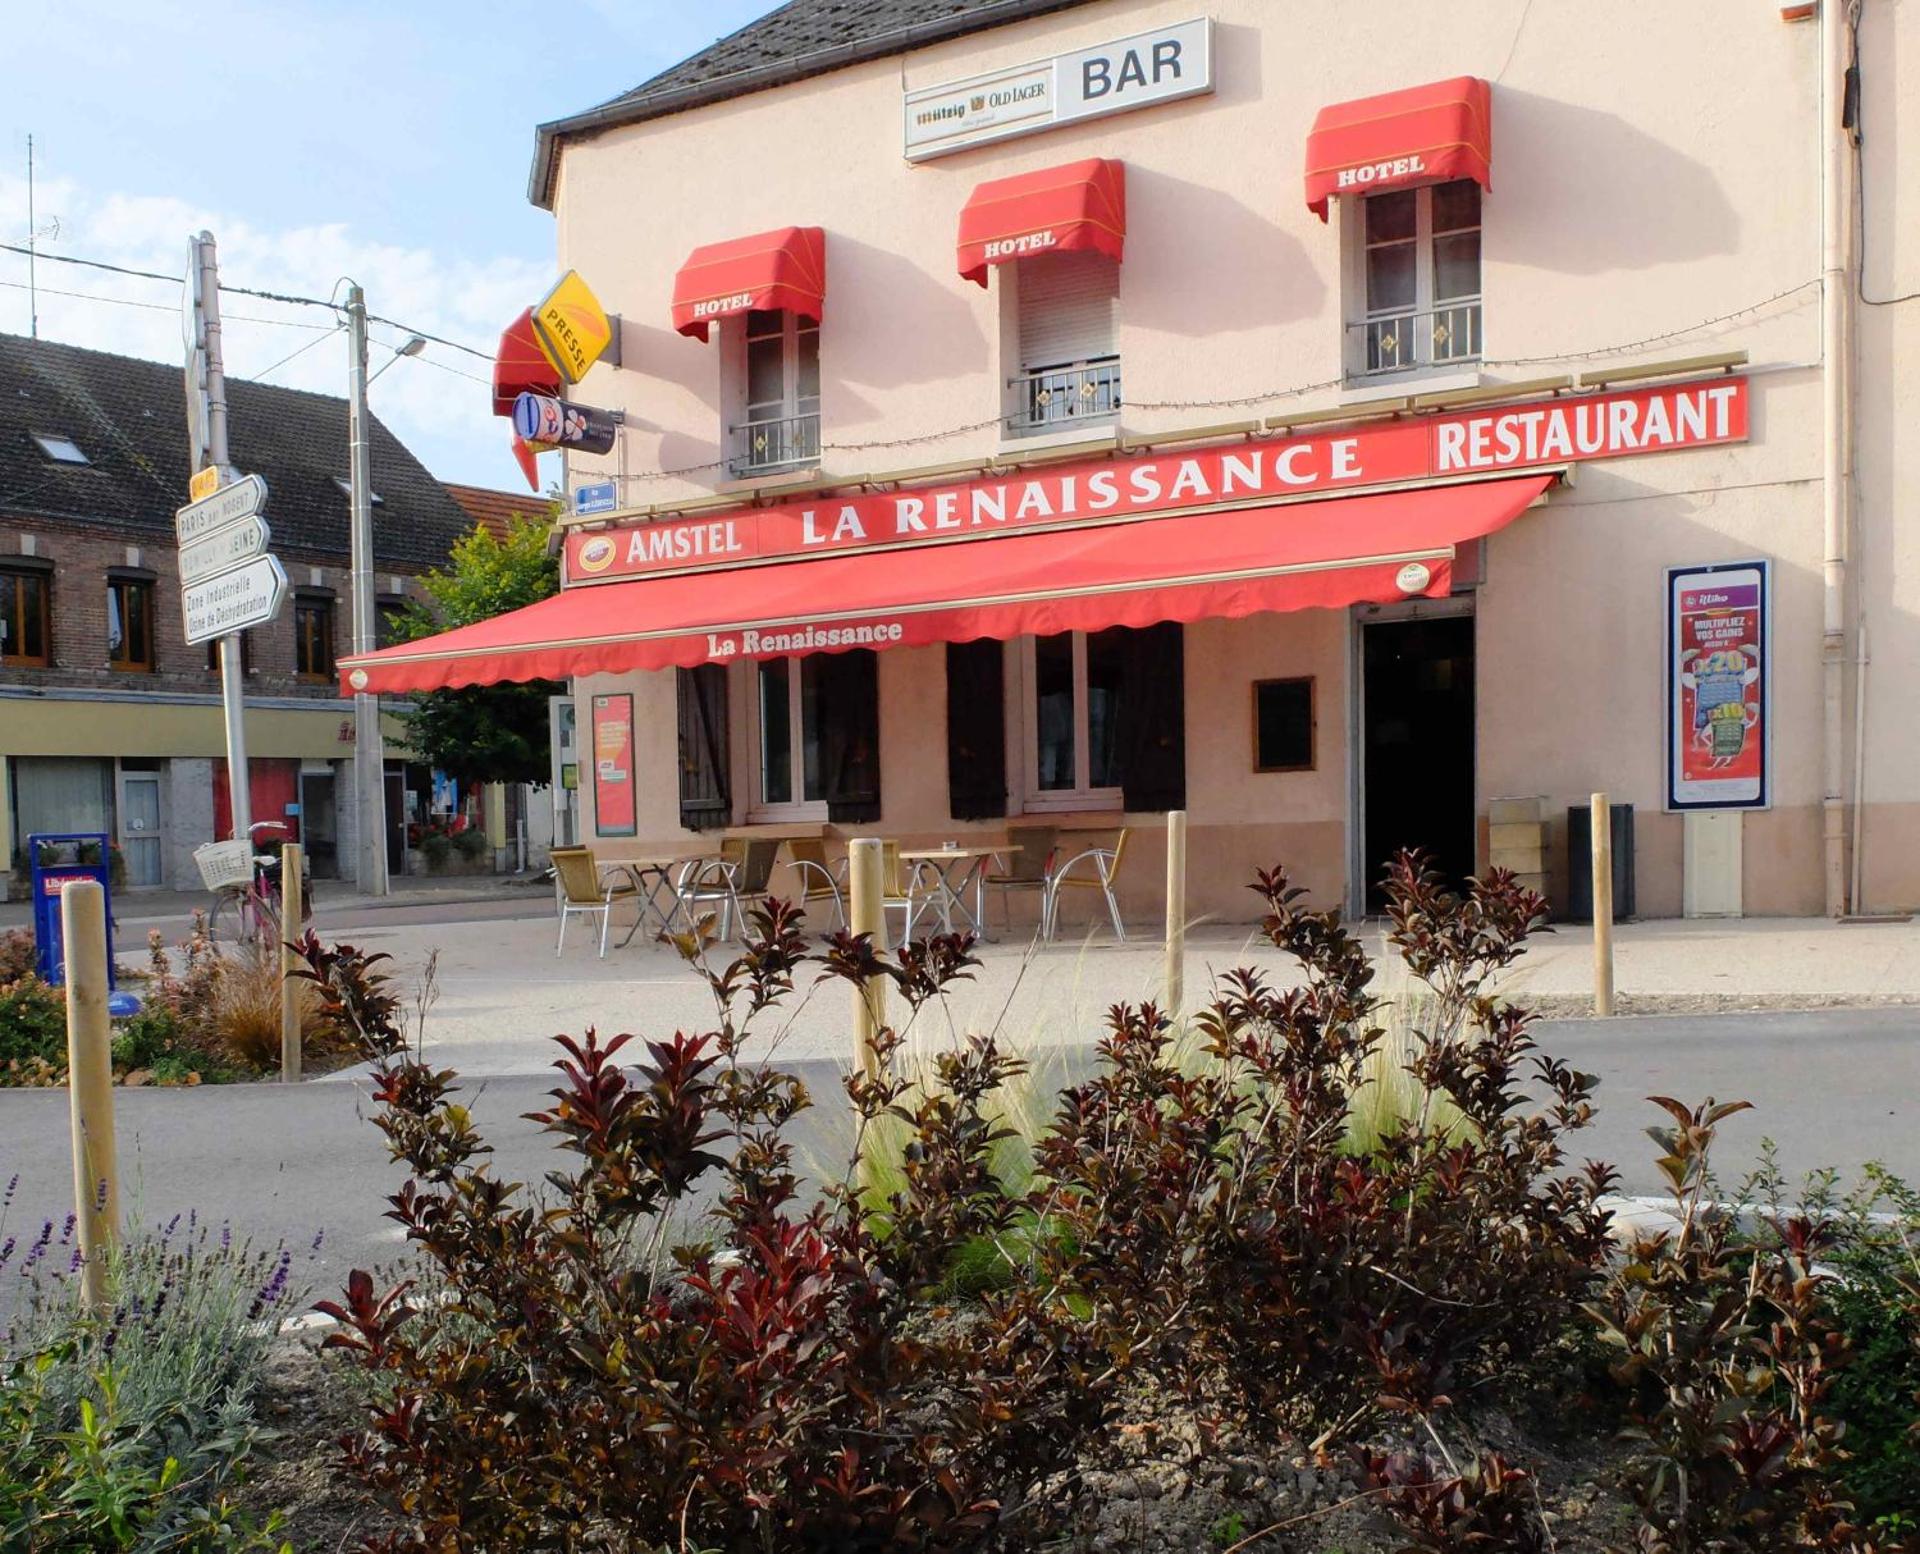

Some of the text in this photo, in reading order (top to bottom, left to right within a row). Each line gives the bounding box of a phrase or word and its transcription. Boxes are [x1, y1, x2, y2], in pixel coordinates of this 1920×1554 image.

[1082, 39, 1182, 101] BAR
[989, 91, 1011, 108] OLD
[1013, 83, 1046, 103] LAGER
[1338, 155, 1425, 188] HOTEL
[984, 230, 1056, 258] HOTEL
[693, 293, 753, 318] HOTEL
[548, 308, 586, 371] PRESSE
[1438, 386, 1737, 470] RESTAURANT
[801, 438, 1364, 545] LA RENAISSANCE
[181, 510, 206, 533] PARIS
[626, 521, 742, 564] AMSTEL
[187, 577, 250, 612] Zone Industrielle
[189, 595, 267, 634] Usine de Déshydratation
[1694, 616, 1746, 630] MULTIPLIEZ
[707, 622, 903, 658] La Renaissance
